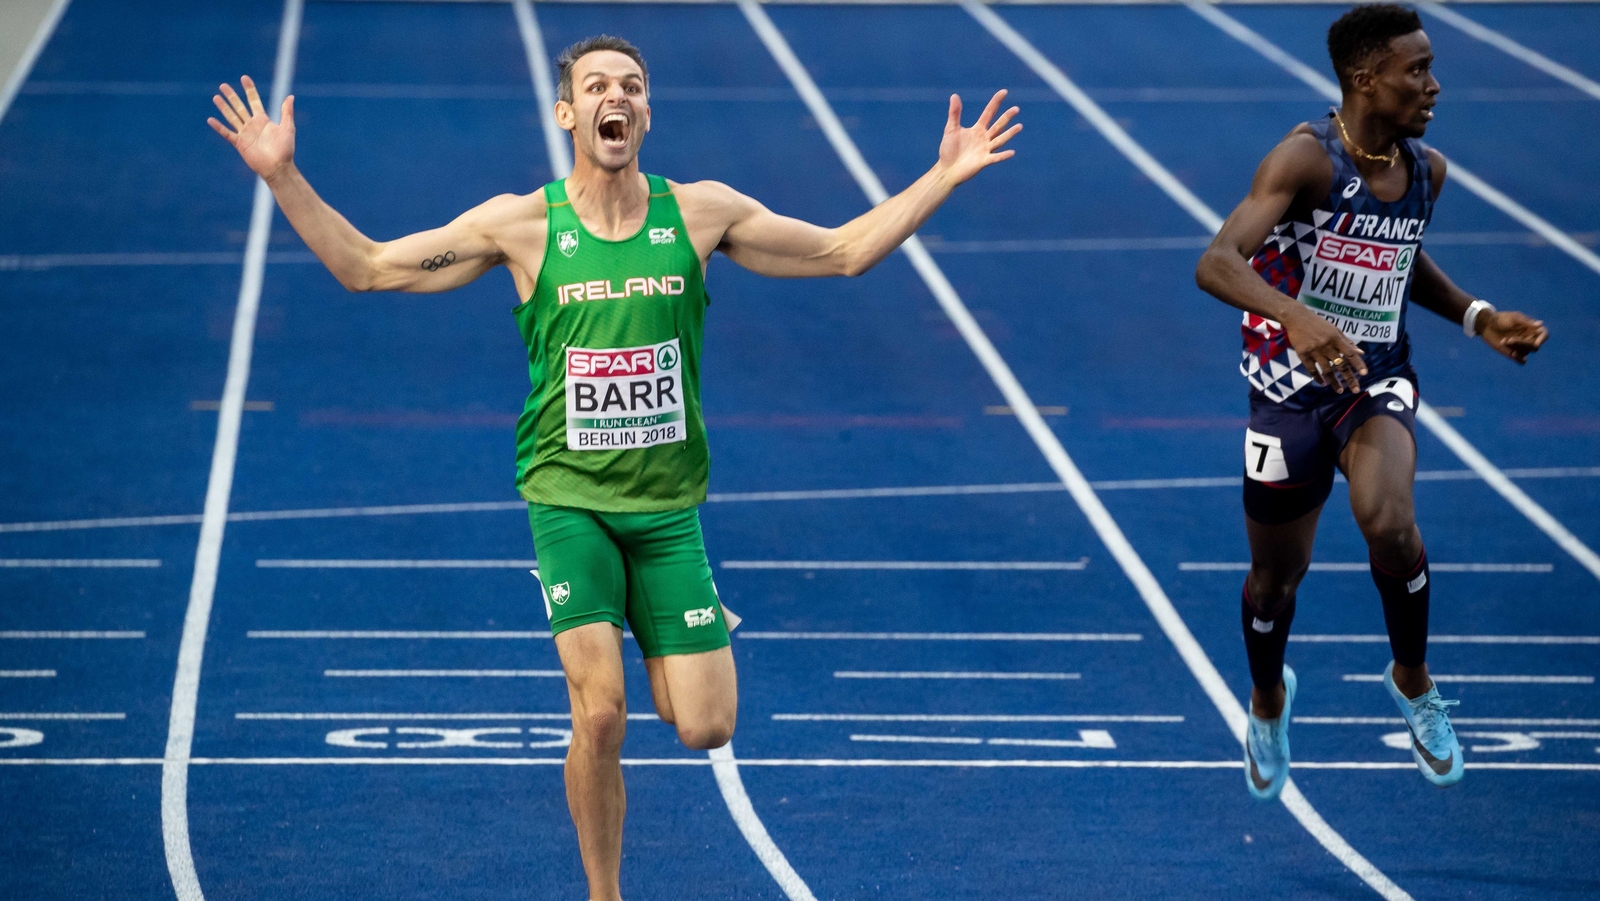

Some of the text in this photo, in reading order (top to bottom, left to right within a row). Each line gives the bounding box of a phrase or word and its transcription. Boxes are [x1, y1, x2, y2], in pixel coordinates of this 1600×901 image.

[649, 227, 676, 238] CX
[650, 236, 676, 245] SPORT
[1319, 237, 1394, 269] SPAR
[558, 275, 685, 305] IRELAND
[1310, 262, 1404, 306] VAILLANT
[1328, 303, 1351, 315] RUN
[1361, 323, 1391, 339] 2018
[570, 353, 653, 375] SPAR
[574, 376, 678, 412] BARR
[599, 417, 622, 428] RUN
[579, 425, 676, 446] BERLIN 2018
[1252, 441, 1270, 473] 7
[684, 606, 716, 622] CX
